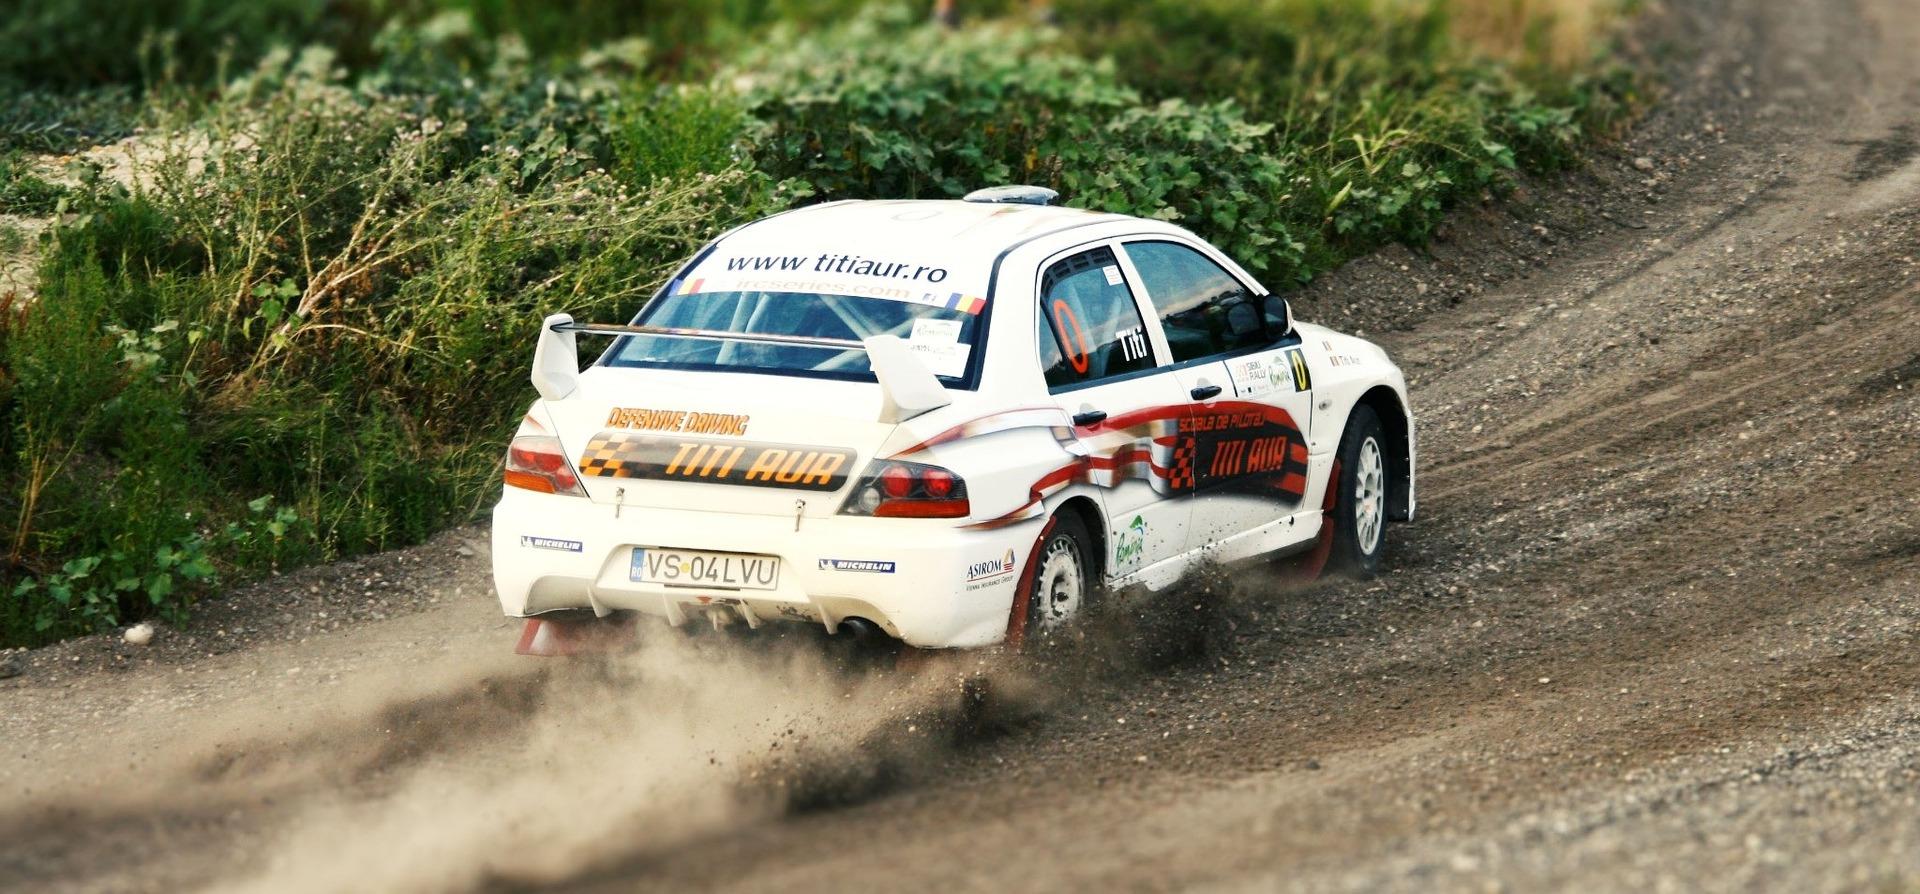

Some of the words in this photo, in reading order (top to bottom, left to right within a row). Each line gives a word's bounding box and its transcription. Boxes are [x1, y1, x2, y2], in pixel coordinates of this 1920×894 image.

[814, 253, 948, 283] titiaur.ro
[1115, 325, 1148, 362] Titi
[605, 407, 687, 432] DEFENSIVE
[683, 411, 750, 437] DRIVING
[664, 443, 747, 479] TITI
[745, 448, 847, 486] AUR
[1210, 440, 1248, 477] TITI
[534, 538, 580, 550] MICHELIN
[836, 561, 893, 571] MICHELIN
[966, 559, 1002, 580] ASIROM
